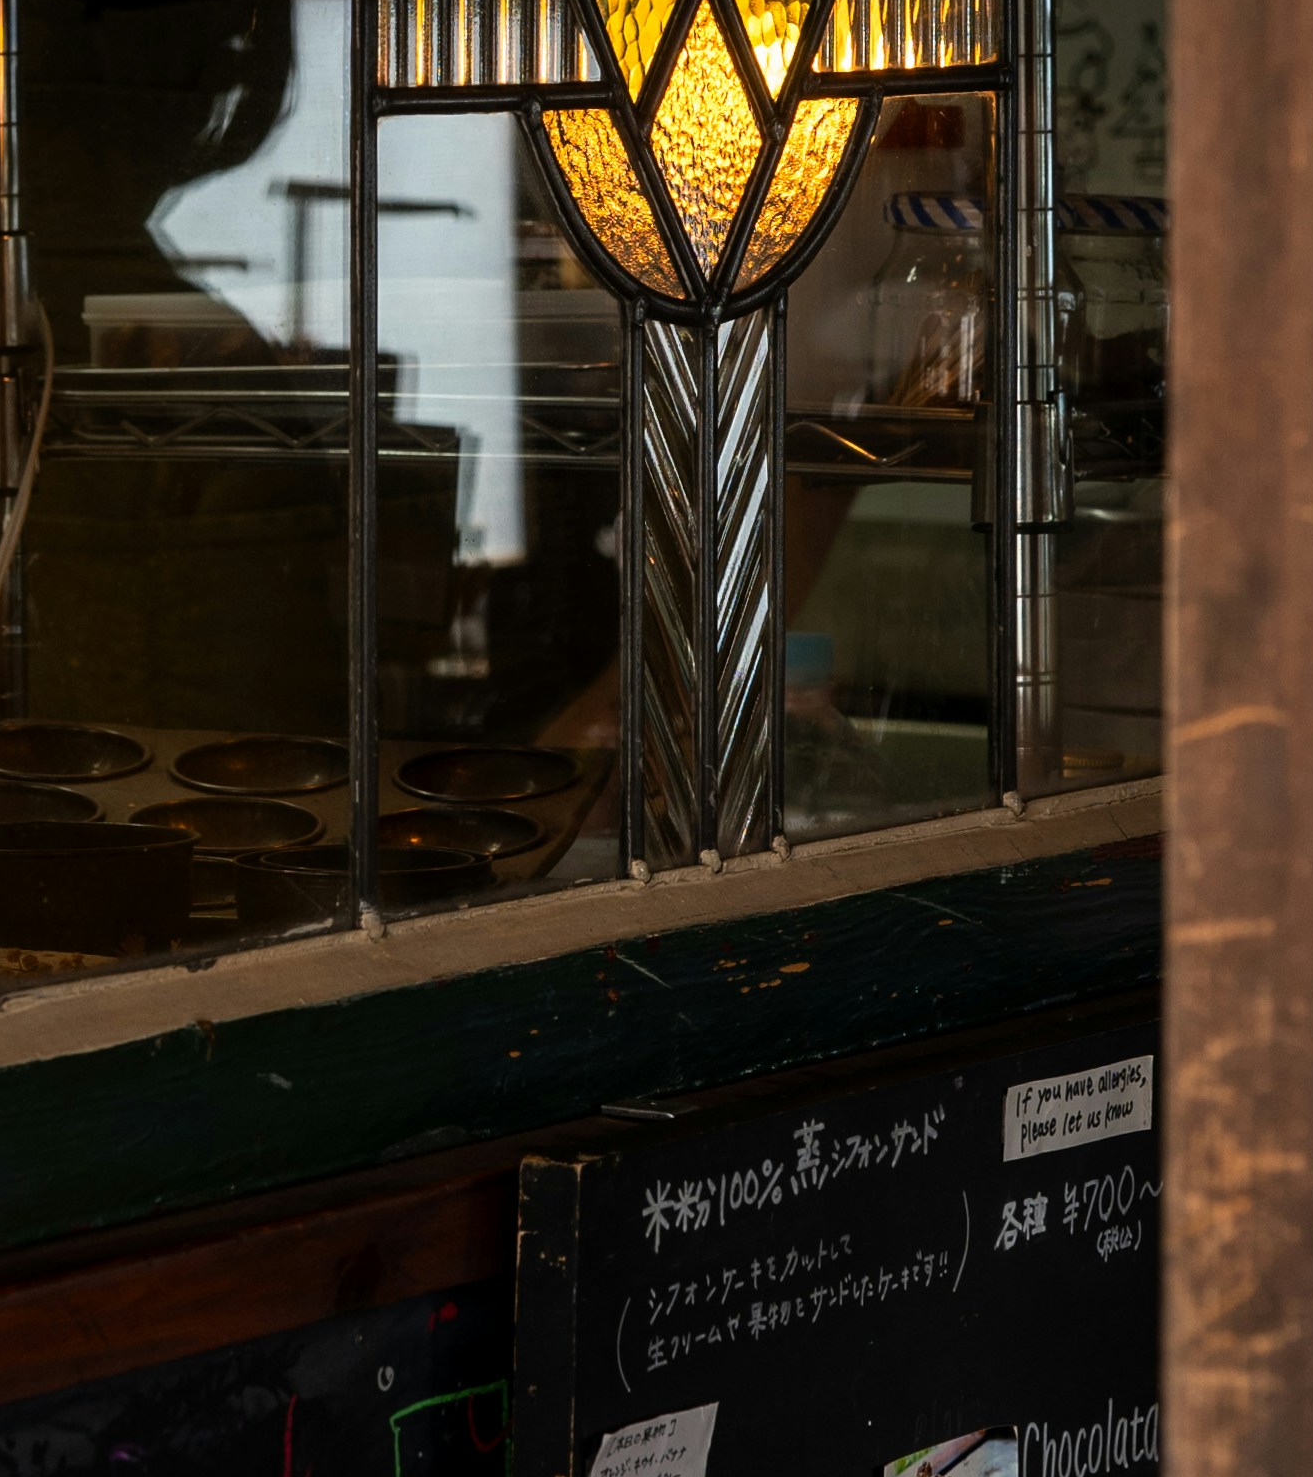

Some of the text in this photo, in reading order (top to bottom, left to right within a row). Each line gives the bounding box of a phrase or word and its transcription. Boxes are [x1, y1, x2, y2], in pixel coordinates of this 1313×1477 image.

[1015, 1063, 1147, 1119] If you have allergies,
[1020, 1100, 1134, 1154] please let us know
[993, 1190, 1050, 1251] 各種
